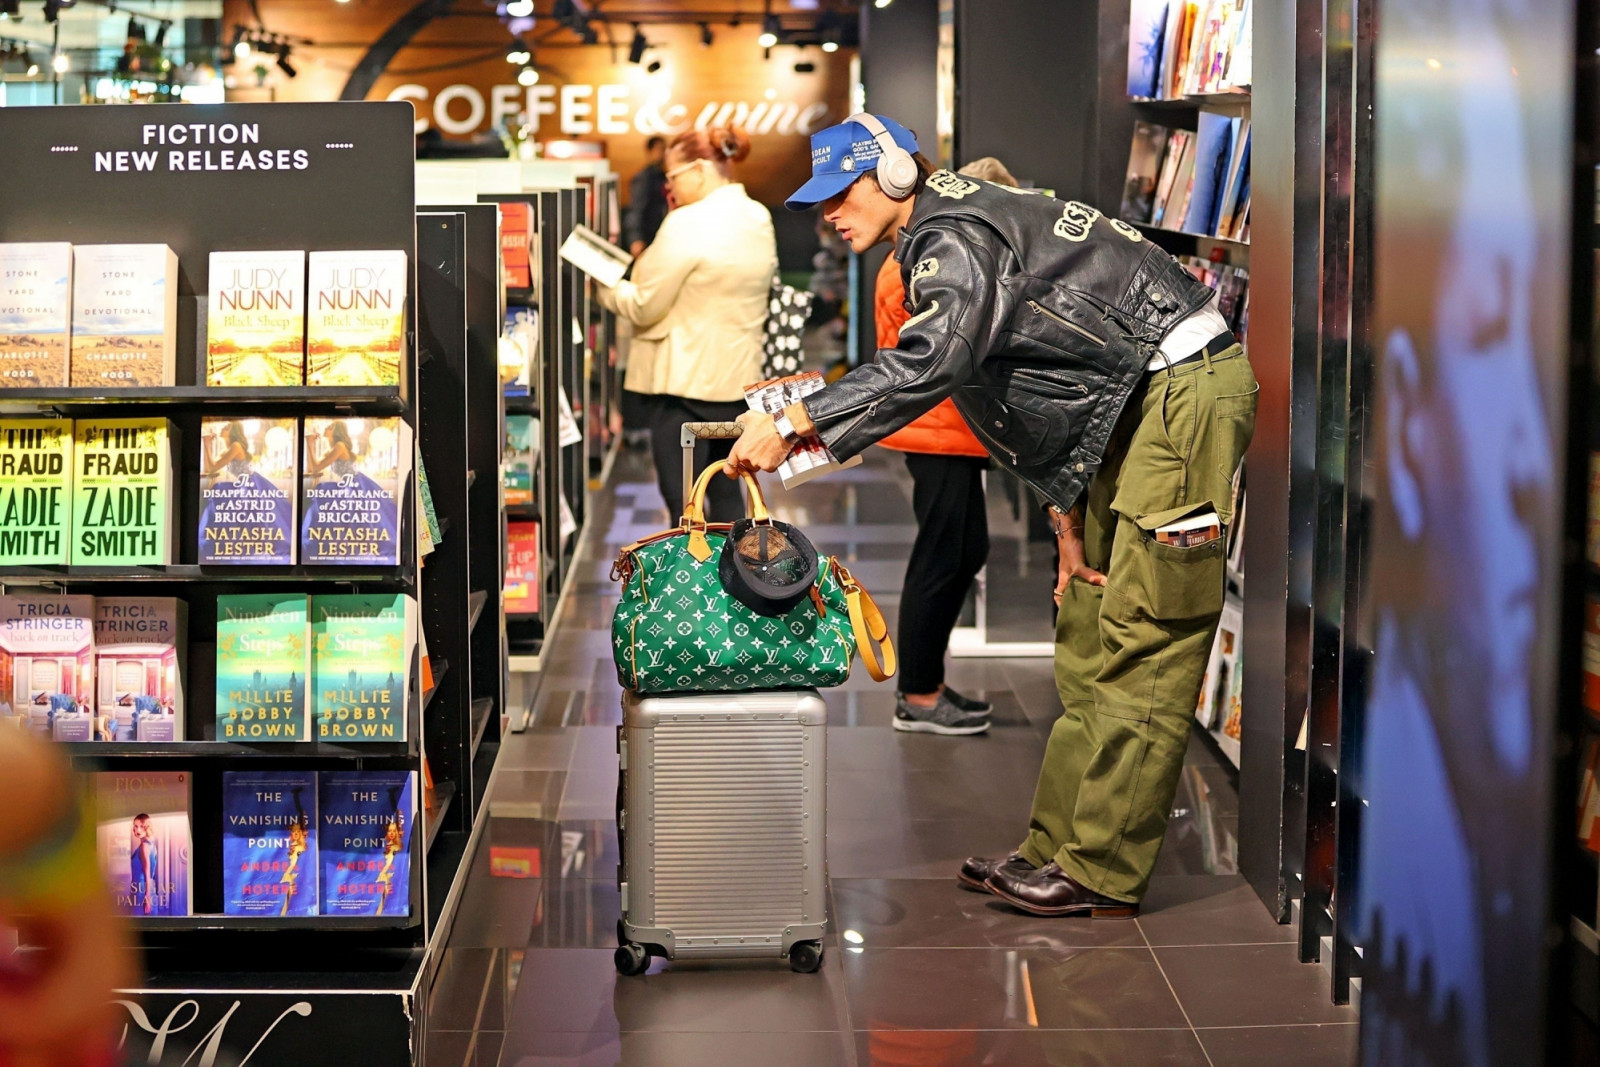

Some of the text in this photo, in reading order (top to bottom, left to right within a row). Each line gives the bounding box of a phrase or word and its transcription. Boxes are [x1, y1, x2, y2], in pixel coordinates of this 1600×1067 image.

[385, 84, 830, 136] COFFEE & wine
[142, 123, 259, 145] FICTION
[814, 146, 830, 156] DEAN
[95, 149, 309, 172] NEW RELEASES
[226, 268, 287, 290] JUDY
[326, 268, 386, 290] JUDY
[219, 290, 293, 311] NUNN
[319, 289, 392, 310] NUNN
[224, 314, 290, 330] Black Sheep
[323, 314, 389, 330] Black Sheep
[0, 351, 49, 360] ARLOTTE
[86, 352, 148, 360] CHARLOTTE
[3, 370, 34, 378] WOOD
[101, 371, 132, 379] WOOD
[4, 428, 48, 449] THE
[100, 428, 142, 449] THE
[0, 454, 63, 476] RAUD
[84, 452, 158, 476] FRAUD
[232, 473, 255, 488] The
[336, 473, 360, 488] The
[203, 489, 289, 498] DISAPPEARANCE
[306, 489, 394, 499] DISAPPEARANCE
[0, 486, 62, 526] ADIE
[82, 486, 158, 527] ZADIE
[216, 500, 276, 510] of ASTRID
[319, 500, 380, 511] of ASTRID
[214, 512, 276, 523] BRICARD
[318, 512, 382, 523] BRICARD
[205, 527, 286, 540] NATASHA
[308, 527, 390, 541] NATASHA
[81, 530, 156, 556] SMITH
[214, 542, 276, 556] LESTER
[318, 542, 380, 556] LESTER
[18, 604, 72, 616] TRICIA
[102, 606, 156, 618] TRICIA
[224, 606, 300, 624] Nineteen
[320, 606, 398, 624] Nineteen
[6, 618, 84, 630] STRINGER
[10, 632, 79, 642] back on track
[121, 636, 133, 644] on
[136, 634, 164, 644] track
[239, 632, 284, 657] Steps
[334, 632, 382, 657] Steps
[229, 690, 293, 704] MILLIE
[324, 690, 391, 704] MILLIE
[229, 706, 293, 720] BOBBY
[324, 706, 391, 720] BOBBY
[225, 724, 296, 736] BROWN
[320, 724, 394, 737] BROWN
[115, 778, 168, 792] FIONA
[256, 792, 282, 802] THE
[352, 792, 378, 802] THE
[248, 838, 292, 849] POINT
[344, 838, 387, 848] POINT
[117, 895, 168, 908] PALACE
